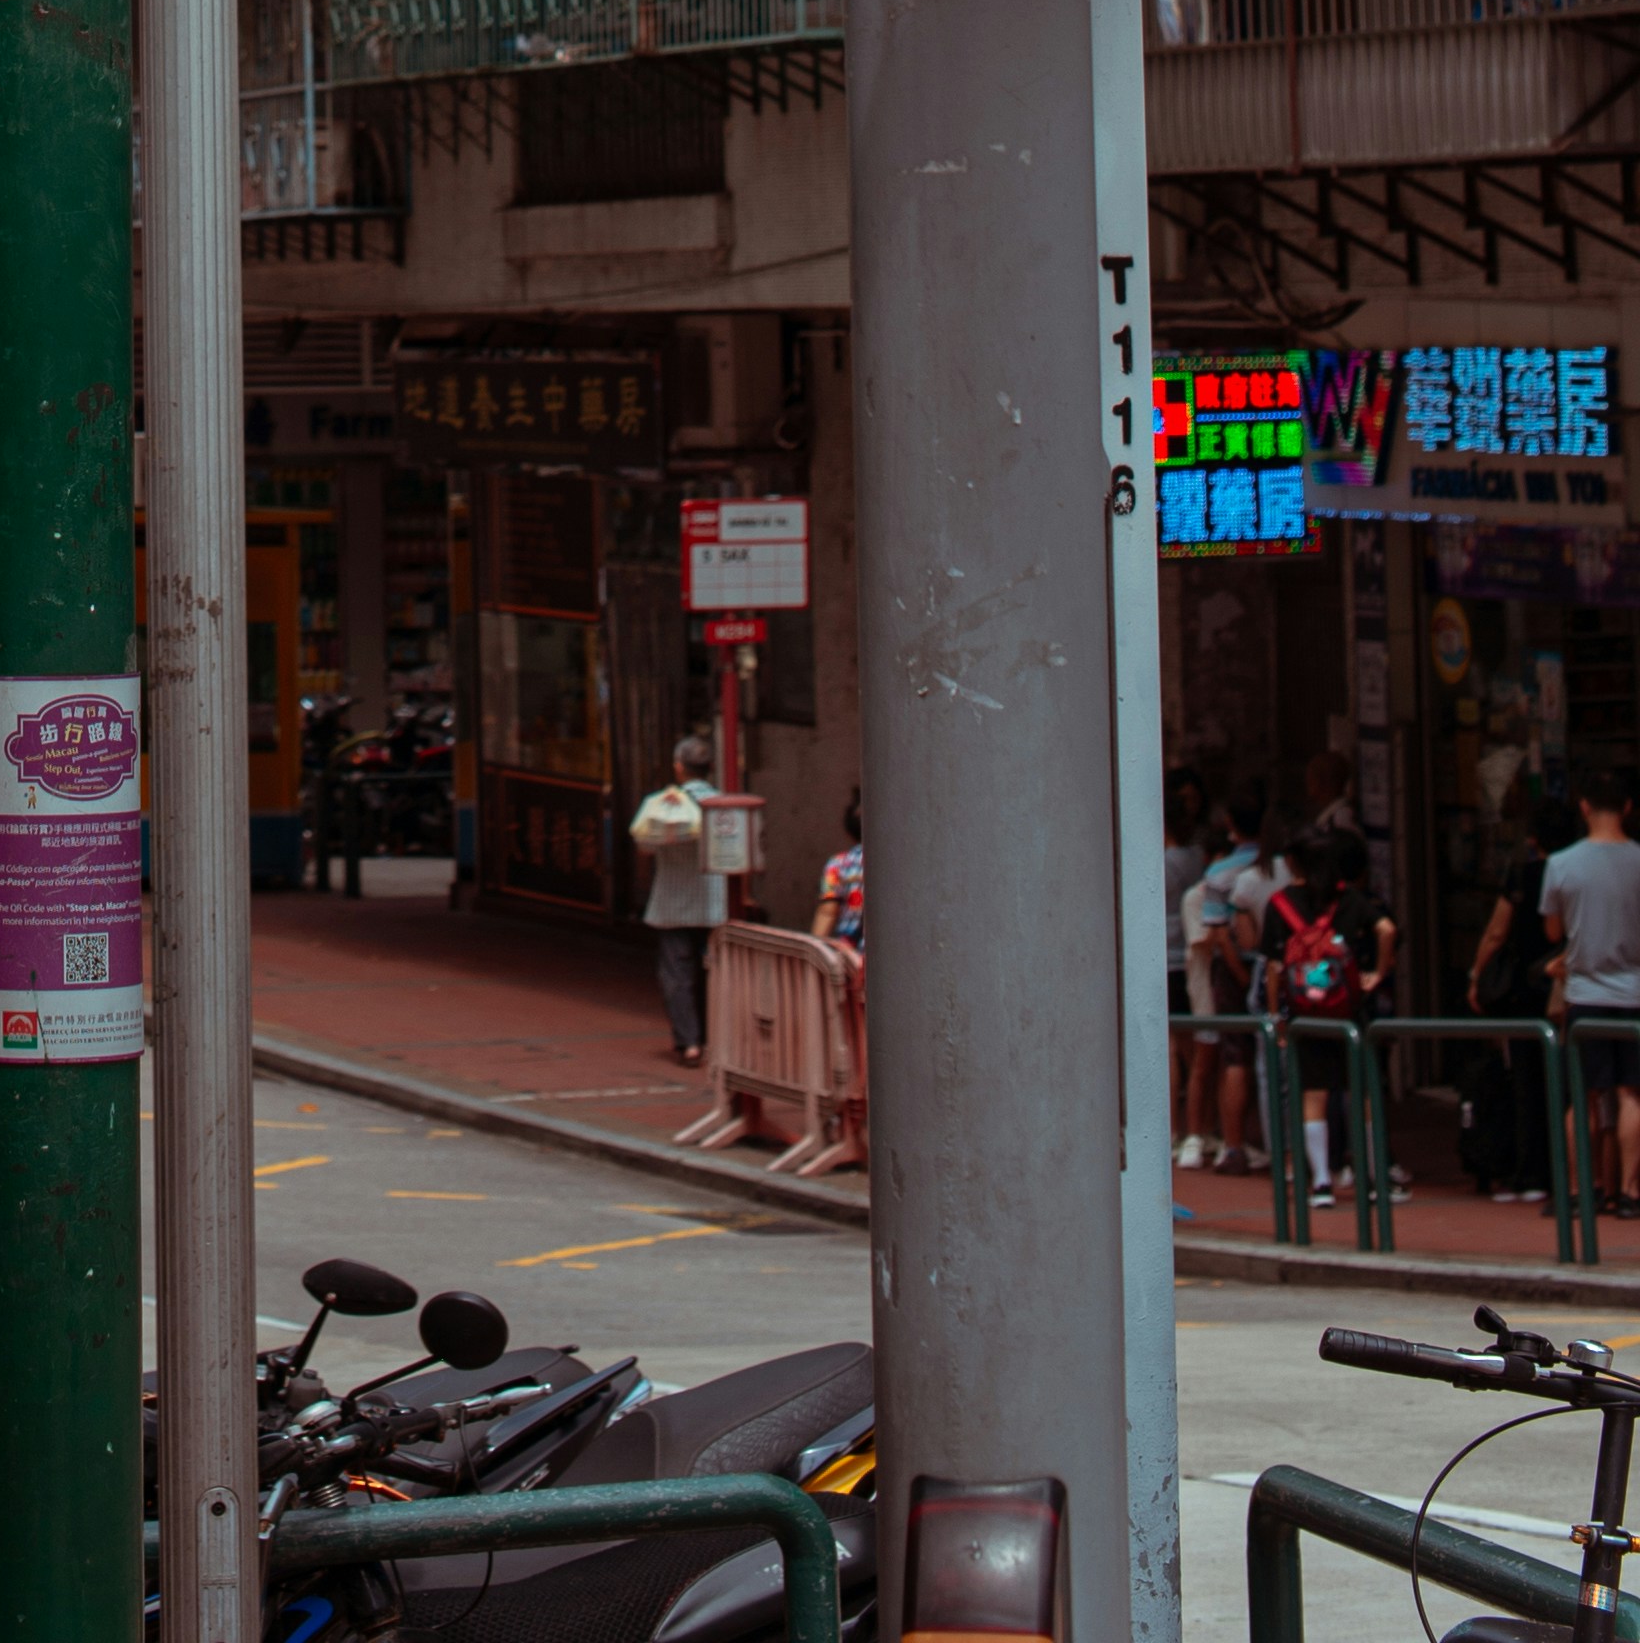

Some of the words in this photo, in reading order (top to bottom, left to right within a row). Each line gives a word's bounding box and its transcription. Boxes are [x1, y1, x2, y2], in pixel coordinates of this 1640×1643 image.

[40, 721, 123, 745] 步行路線
[45, 746, 79, 759] Macau
[44, 762, 63, 776] Step
[64, 763, 83, 776] Out,
[6, 863, 31, 875] Código
[33, 865, 51, 873] com
[35, 878, 54, 888] para
[10, 903, 22, 913] QR
[23, 903, 45, 913] Code
[46, 903, 65, 913] with
[2, 917, 23, 926] more
[24, 916, 75, 926] information
[83, 915, 96, 925] the
